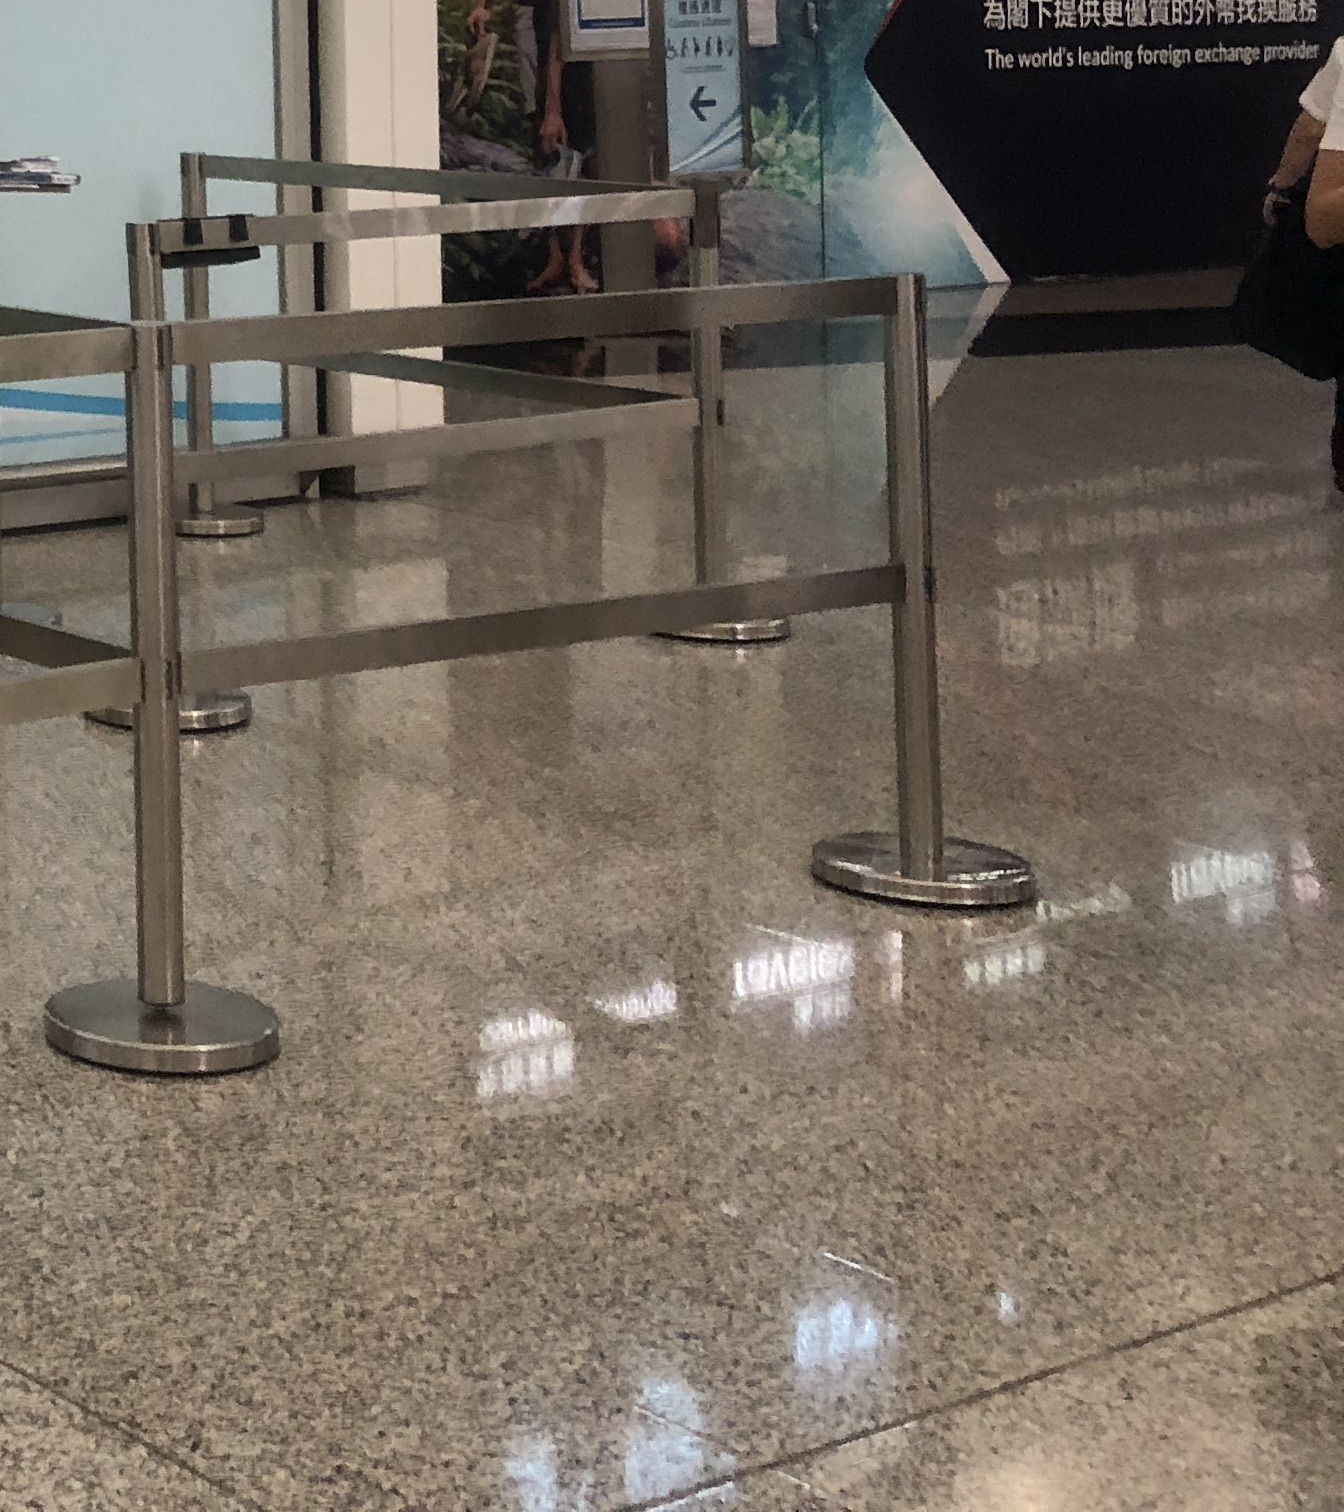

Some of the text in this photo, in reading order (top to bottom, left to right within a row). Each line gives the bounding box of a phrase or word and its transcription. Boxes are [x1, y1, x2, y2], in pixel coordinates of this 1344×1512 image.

[984, 40, 1320, 70] The world's leading foreign exchange provider
